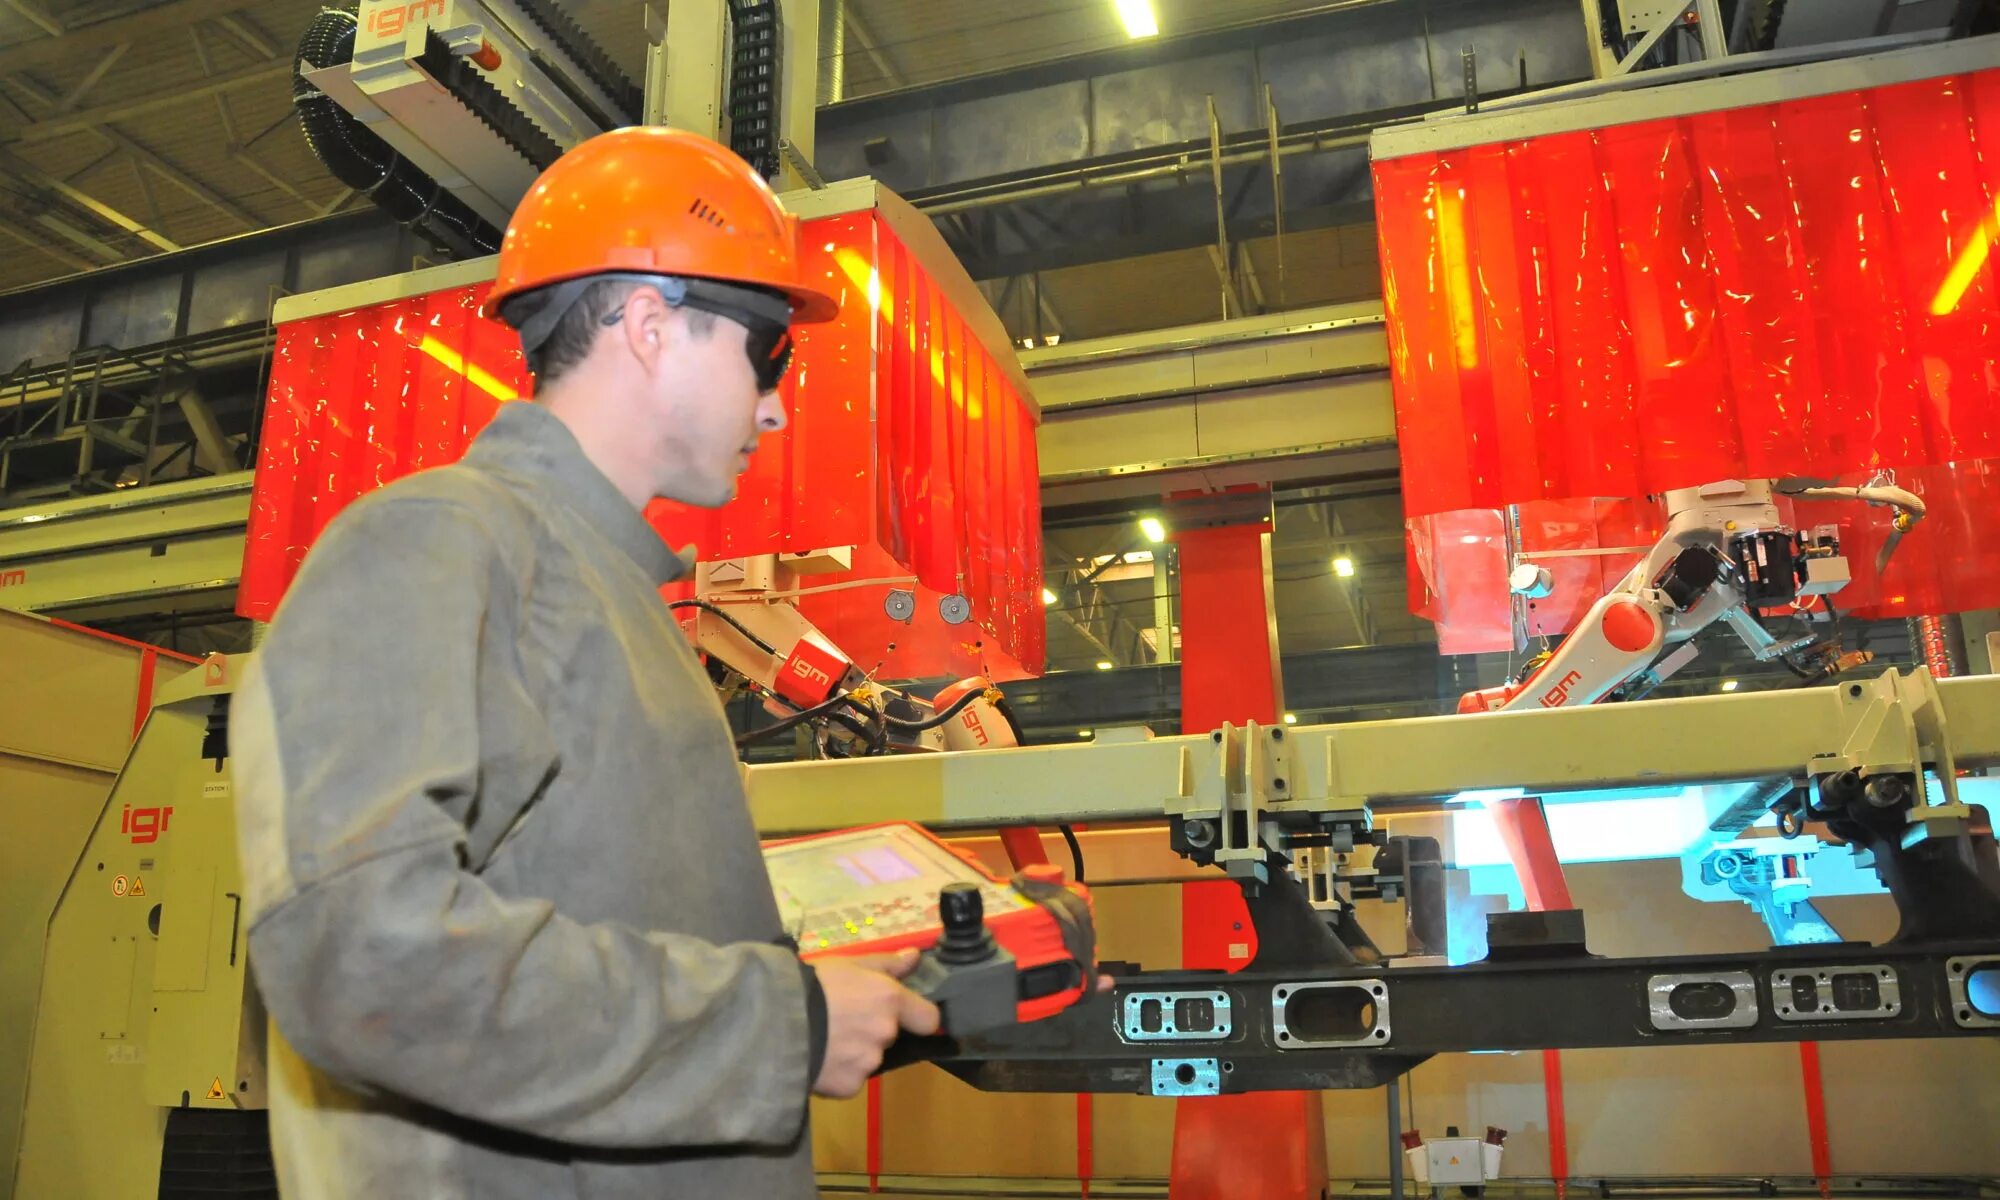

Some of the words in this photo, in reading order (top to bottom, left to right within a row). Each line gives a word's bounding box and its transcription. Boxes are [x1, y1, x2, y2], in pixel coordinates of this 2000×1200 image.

[367, 0, 445, 38] igm
[791, 655, 830, 686] igm
[1538, 670, 1581, 708] igm
[962, 704, 989, 746] igm
